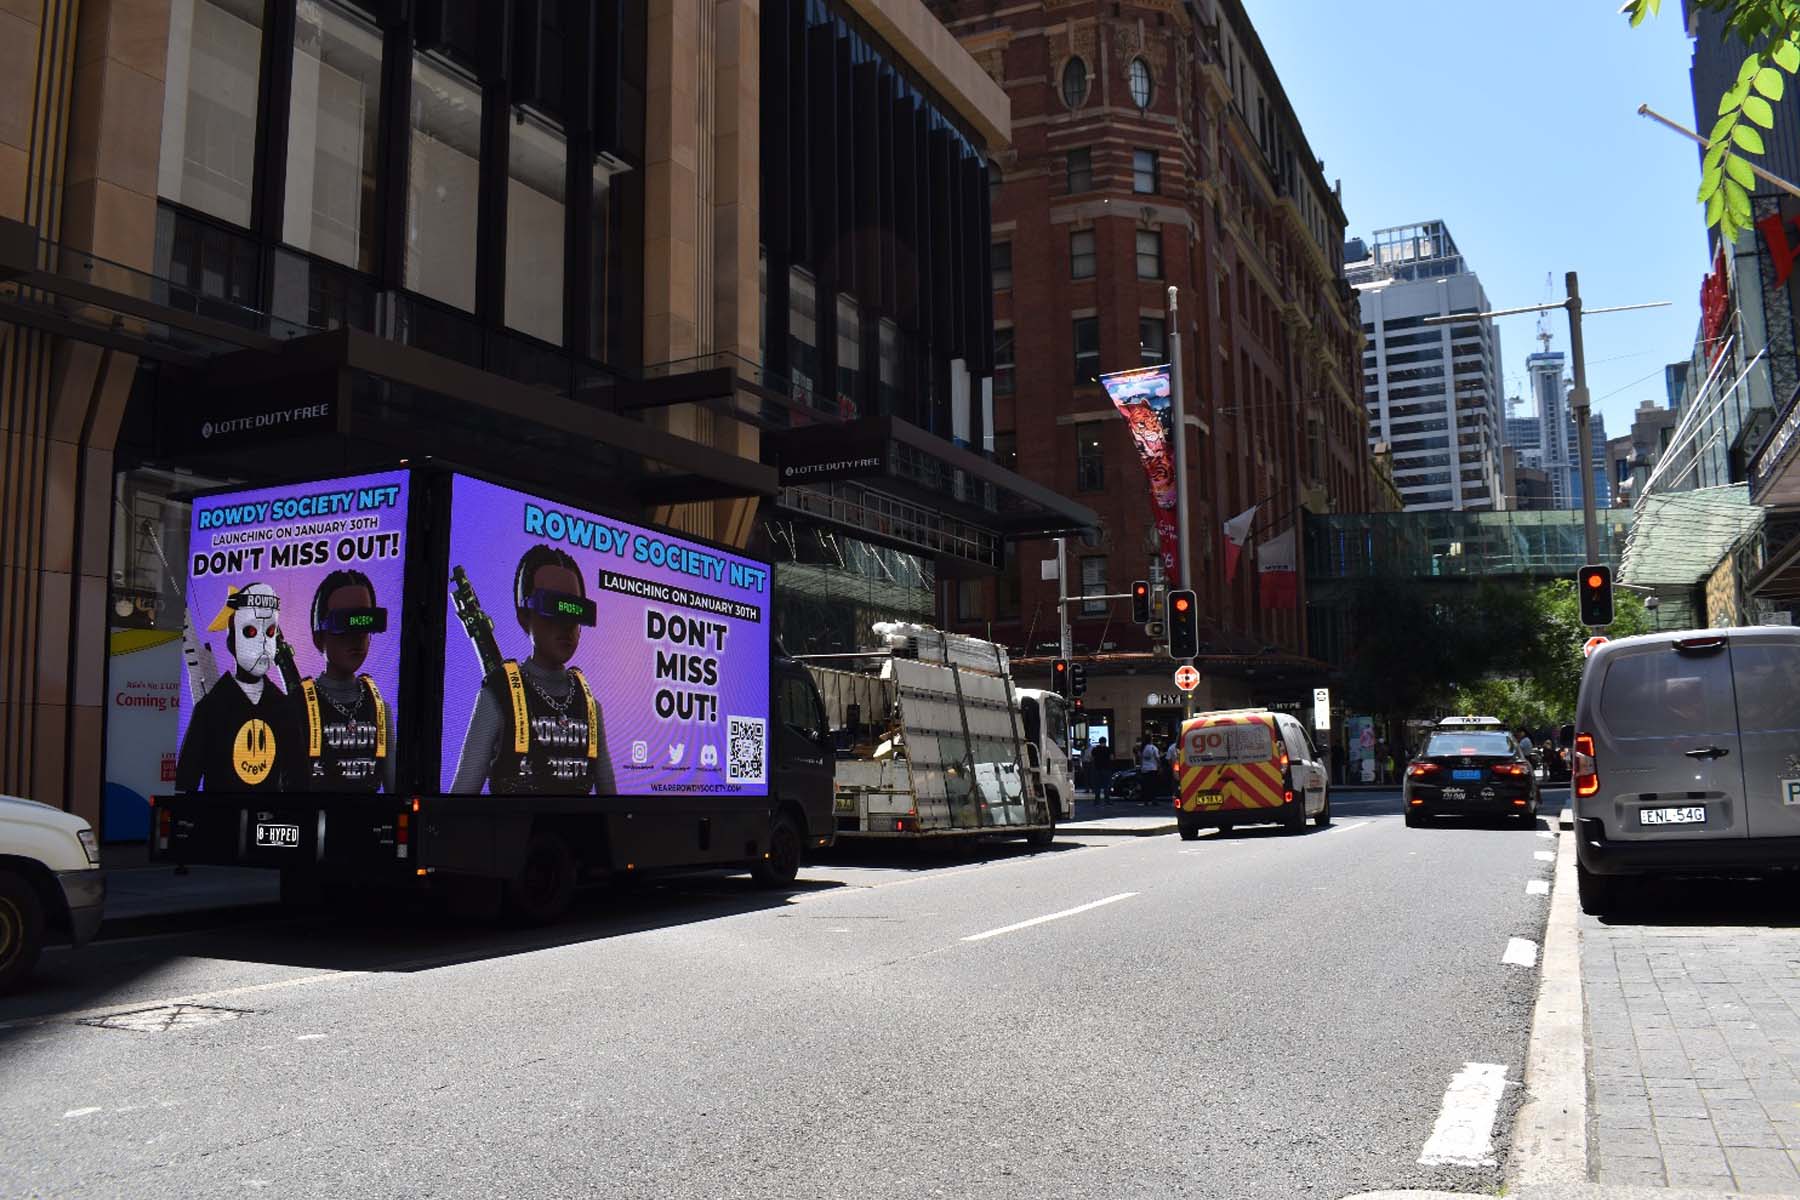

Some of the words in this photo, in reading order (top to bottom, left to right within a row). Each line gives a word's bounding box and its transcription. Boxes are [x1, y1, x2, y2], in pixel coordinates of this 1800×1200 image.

[215, 416, 253, 434] LOTTE
[255, 410, 291, 427] DUTY
[293, 403, 329, 421] FREE
[794, 464, 825, 475] LOTTE
[826, 460, 853, 471] DUTY
[854, 457, 880, 469] FREE
[199, 502, 268, 530] ROWDY
[272, 491, 354, 521] SOCIETY
[358, 486, 399, 510] NFT
[212, 528, 274, 546] LAUNCHING
[275, 527, 293, 539] ON
[294, 520, 347, 537] JANUARY
[349, 517, 378, 530] 30TH
[524, 503, 630, 556] ROWDY
[633, 536, 727, 582] SOCIETY
[729, 562, 767, 592] NFT
[193, 547, 265, 576] DON'T
[270, 540, 332, 569] MISS
[336, 532, 400, 562] OUT!
[603, 573, 670, 601] LAUNCHING
[671, 589, 688, 603] ON
[689, 592, 735, 614] JANUARY
[734, 604, 758, 621] 30TH
[646, 609, 728, 651] DON'T
[655, 650, 718, 686] MISS
[115, 692, 167, 712] Coming
[655, 688, 718, 723] OUT!
[1276, 701, 1301, 710] HYPE
[1191, 733, 1222, 753] go
[240, 760, 267, 776] crew
